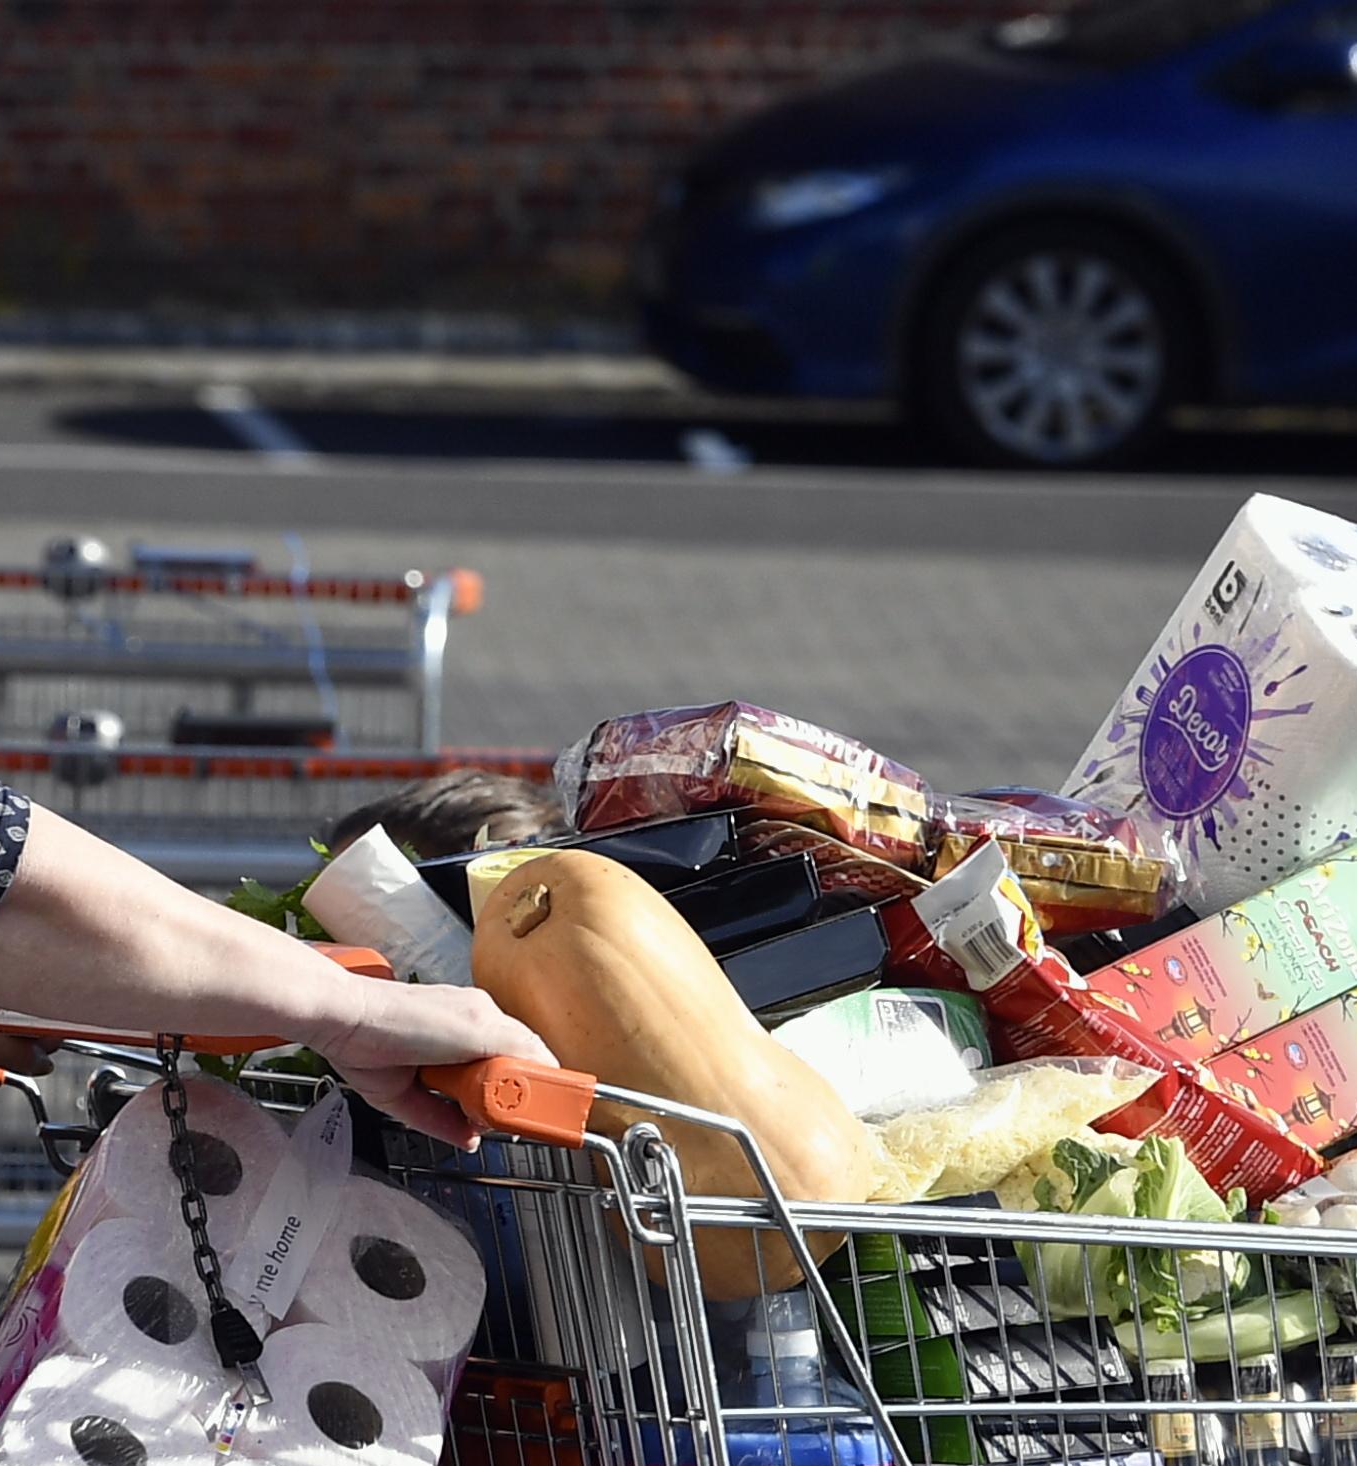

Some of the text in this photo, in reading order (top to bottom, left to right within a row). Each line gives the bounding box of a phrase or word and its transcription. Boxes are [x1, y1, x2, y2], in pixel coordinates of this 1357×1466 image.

[1169, 684, 1230, 765] Decor
[1295, 900, 1340, 972] PEACH
[265, 1216, 302, 1265] home
[255, 1264, 279, 1293] me
